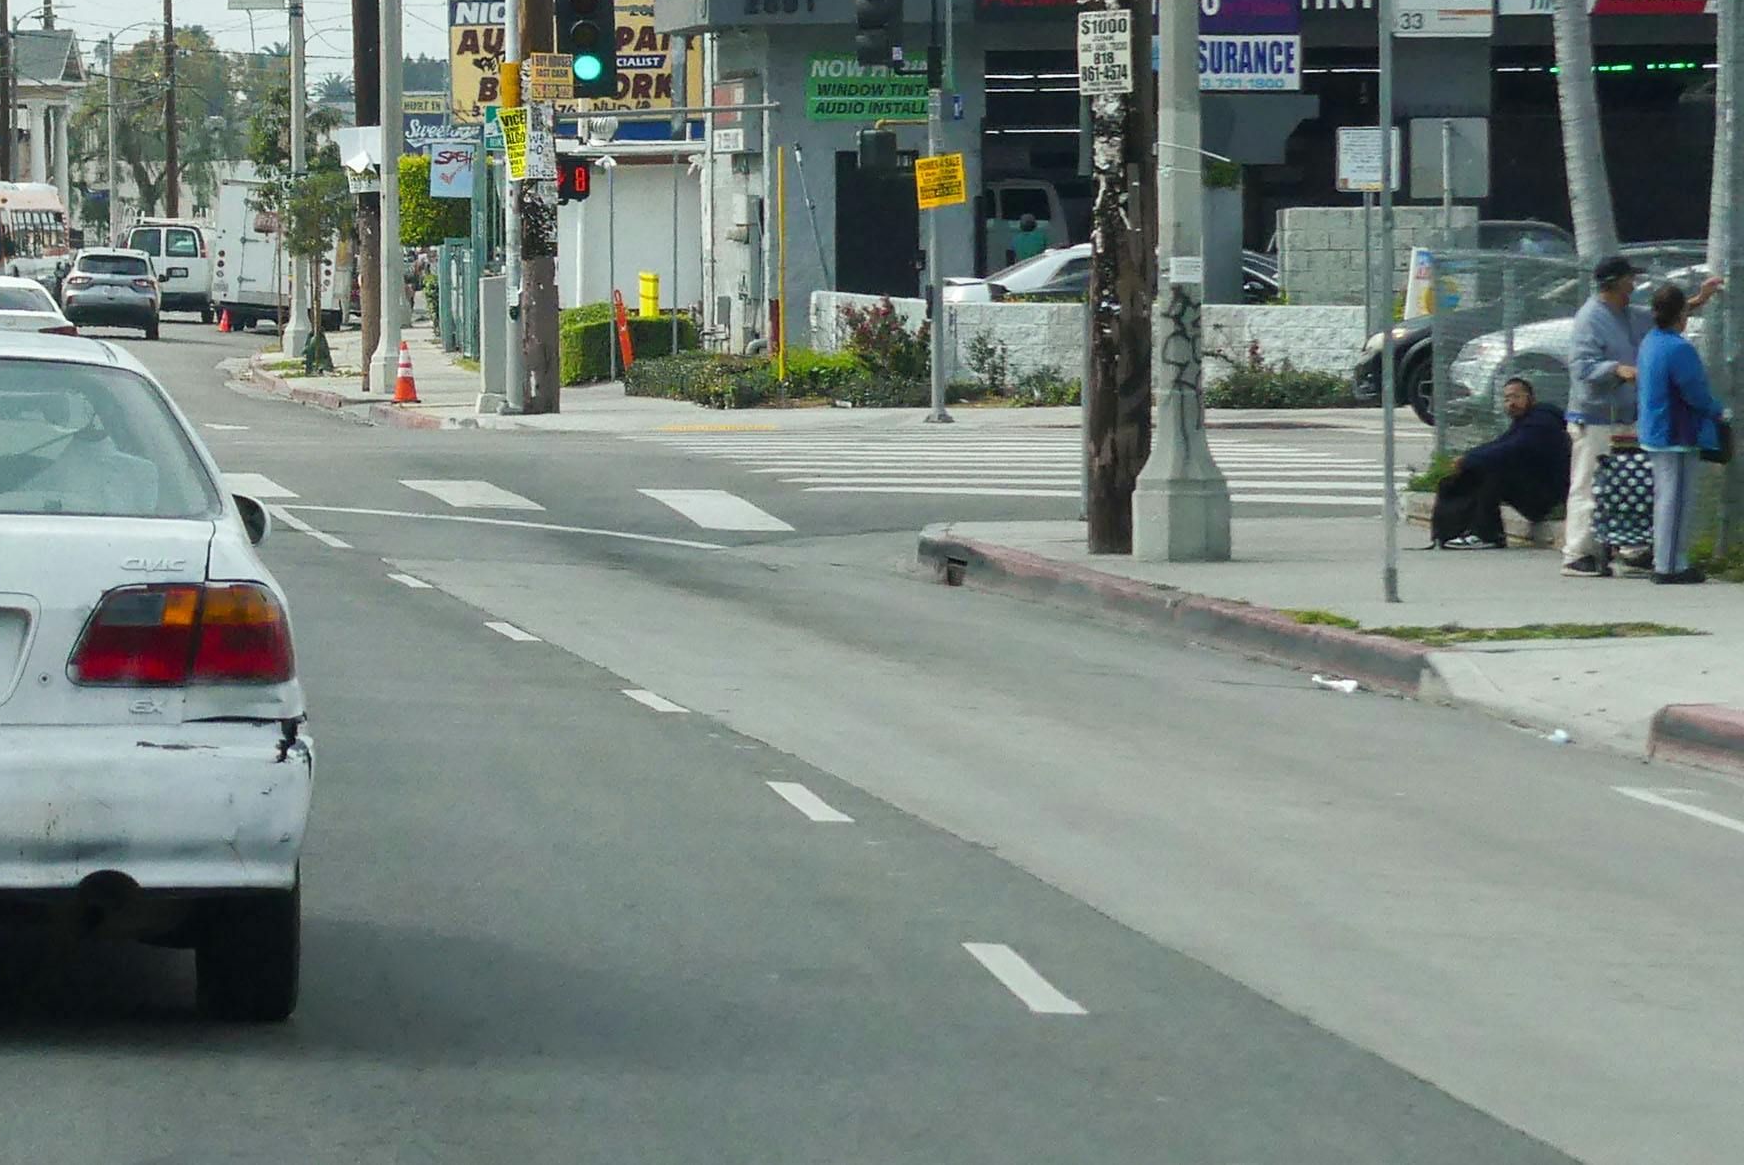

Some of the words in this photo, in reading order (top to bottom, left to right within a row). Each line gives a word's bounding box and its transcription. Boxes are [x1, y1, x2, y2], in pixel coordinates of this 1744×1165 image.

[1081, 18, 1127, 35] $1000
[1399, 12, 1424, 30] 33
[616, 57, 661, 67] CIALIST
[1093, 51, 1115, 65] 818
[1198, 40, 1296, 75] SURANCE
[810, 59, 864, 78] NOW
[616, 73, 673, 100] ORK
[817, 83, 886, 97] WINDOW
[889, 83, 929, 96] TINT
[815, 101, 865, 115] AUDIO
[120, 557, 187, 573] CIVIC
